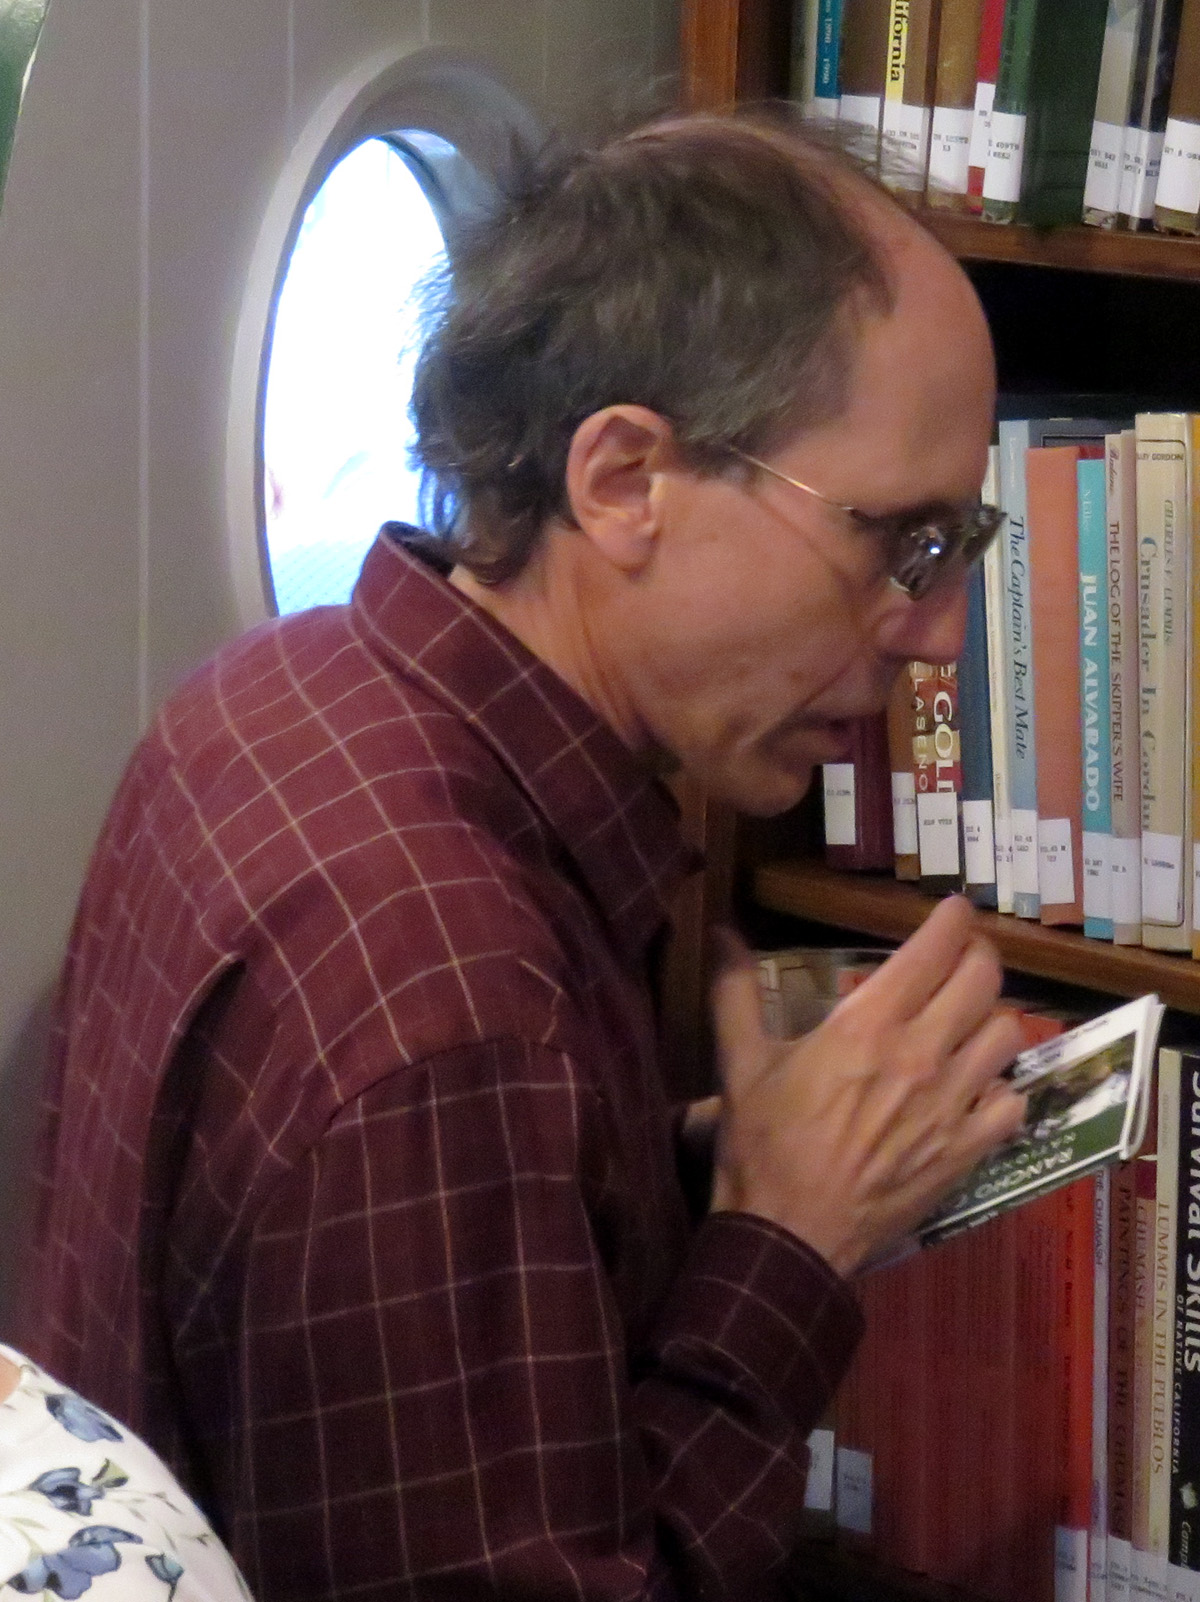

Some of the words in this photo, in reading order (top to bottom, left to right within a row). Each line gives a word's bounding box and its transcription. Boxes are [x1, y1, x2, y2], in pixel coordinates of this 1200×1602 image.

[1010, 517, 1025, 556] The
[1109, 521, 1121, 556] THE
[1110, 560, 1121, 597] LOG
[1140, 536, 1159, 672] Crusader
[1007, 559, 1027, 654] Captain's
[1080, 572, 1098, 646] JUAN
[1110, 602, 1122, 623] OF
[1111, 627, 1122, 664] THE
[1013, 660, 1028, 702] Best
[1015, 705, 1029, 759] Mate
[1084, 658, 1100, 812] ALVARADO
[1111, 672, 1123, 755] SKIPPER'S
[1112, 760, 1124, 802] WIFE
[1157, 1202, 1170, 1292] LUMMIS
[1155, 1299, 1168, 1321] IN
[1154, 1329, 1168, 1374] THE
[1173, 1320, 1184, 1377] NATIVE
[1152, 1379, 1166, 1475] PUEBLOS
[1170, 1383, 1182, 1475] CALIFORNIA
